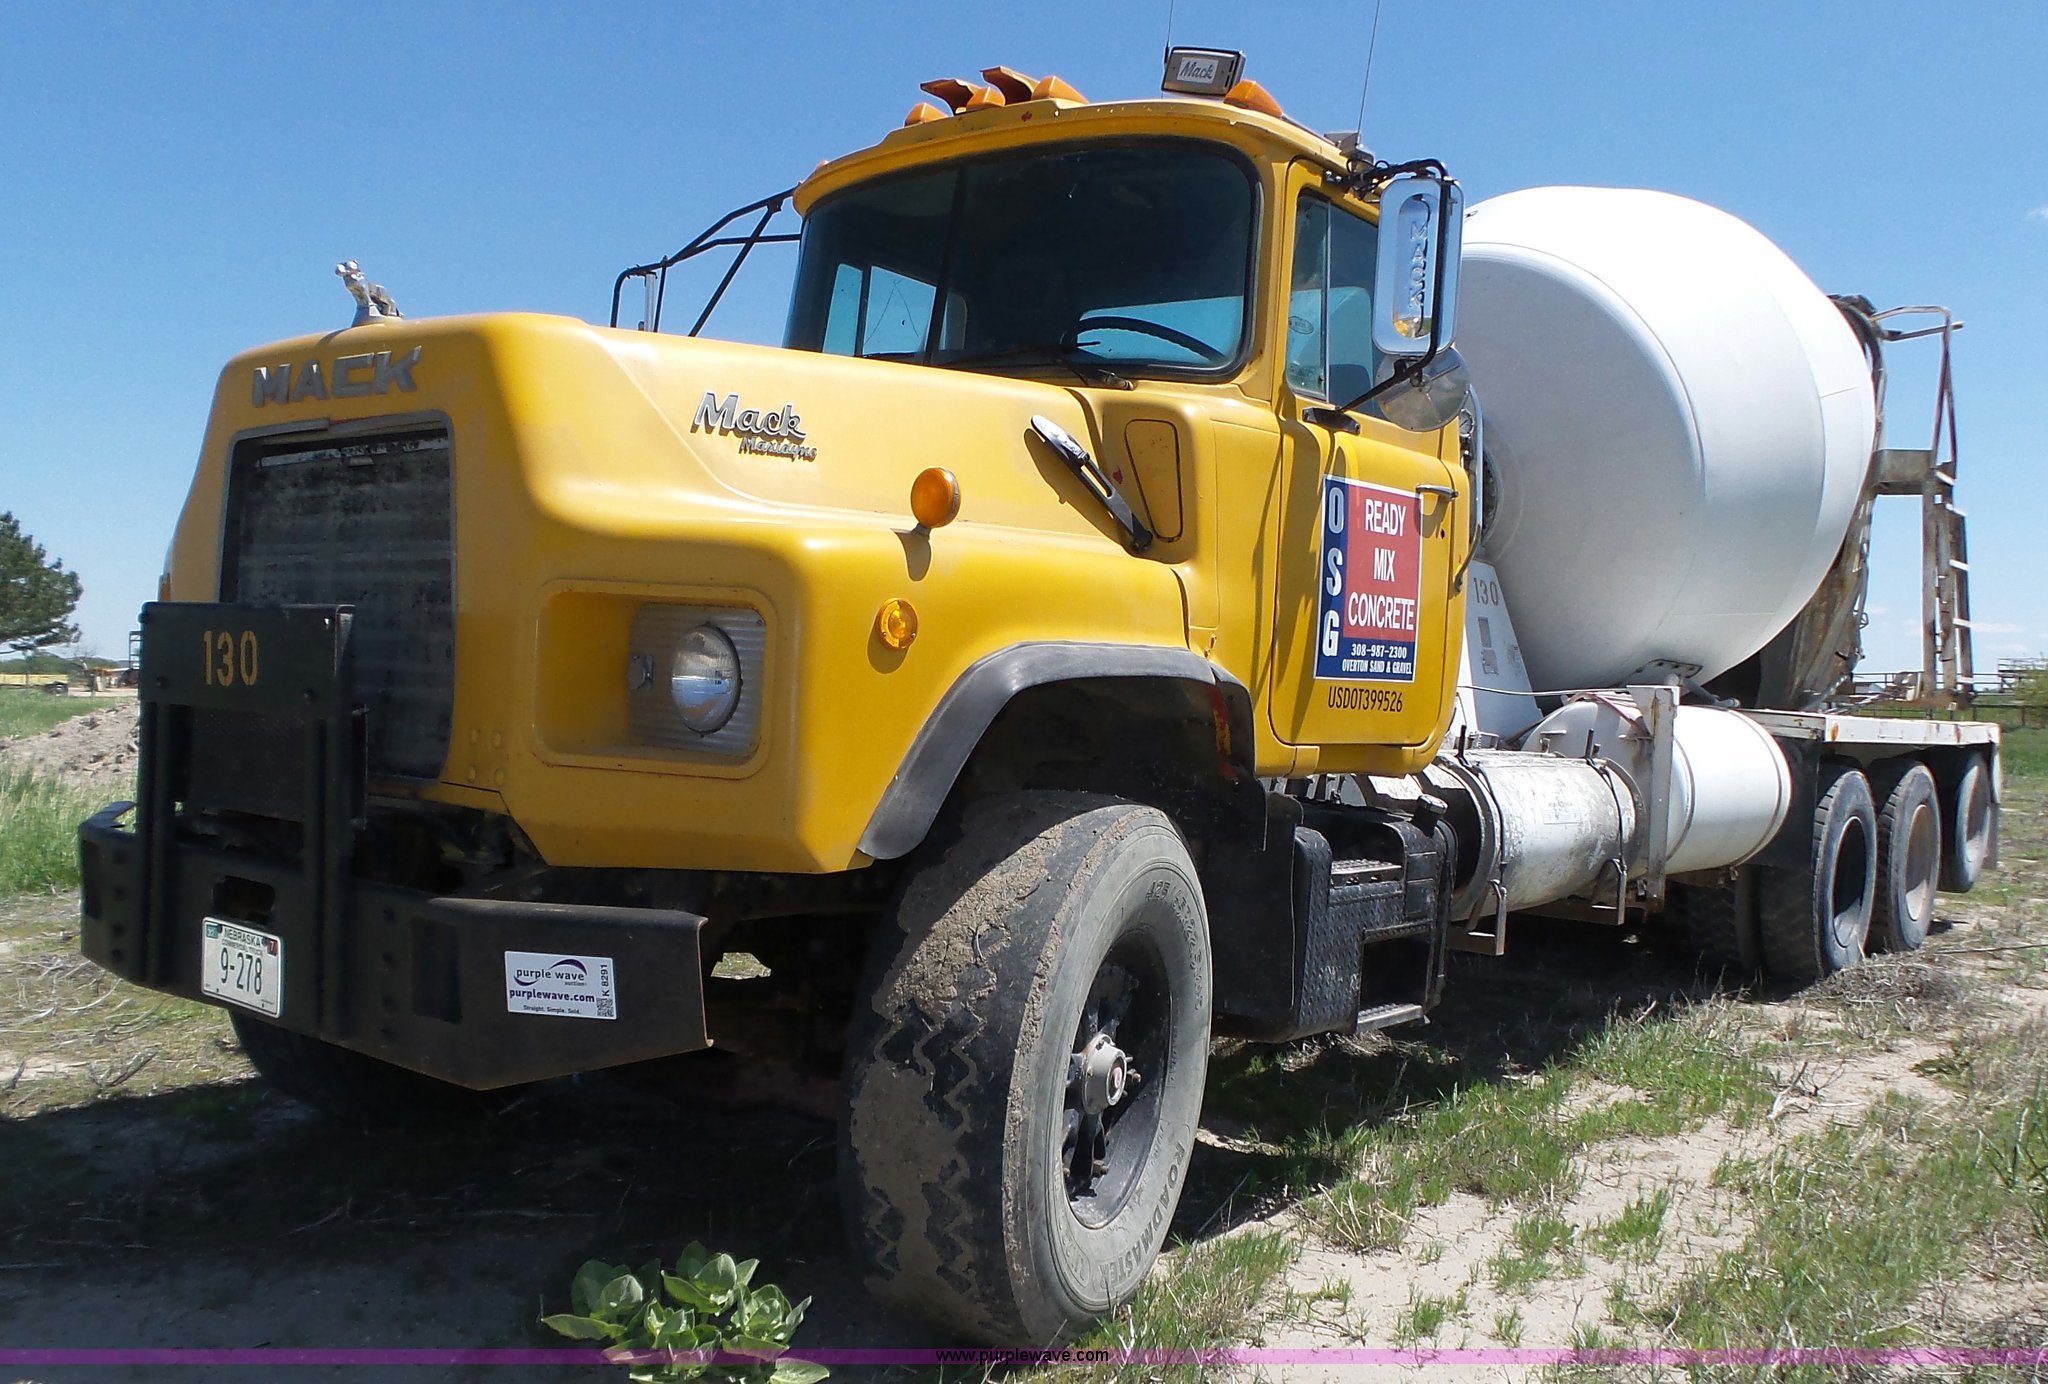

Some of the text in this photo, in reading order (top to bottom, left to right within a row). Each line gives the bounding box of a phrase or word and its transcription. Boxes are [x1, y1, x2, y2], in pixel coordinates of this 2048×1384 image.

[1180, 61, 1213, 79] Mack
[252, 345, 422, 408] MACK
[691, 391, 808, 442] Mack
[1364, 498, 1407, 537] READY
[1373, 547, 1396, 583] MIX
[1473, 577, 1499, 607] 130
[1347, 591, 1416, 631] CONCRETE
[203, 630, 258, 687] 130
[1350, 643, 1408, 659] 308-987-2300
[1341, 659, 1413, 675] OVERTON SAND & GRAVEL
[1327, 686, 1403, 713] USDOT399526
[223, 927, 261, 947] NEBRASKA
[220, 947, 263, 995] 9-278
[516, 968, 585, 981] purple wave
[600, 964, 610, 997] K 8291
[509, 988, 596, 1003] purplewave.com
